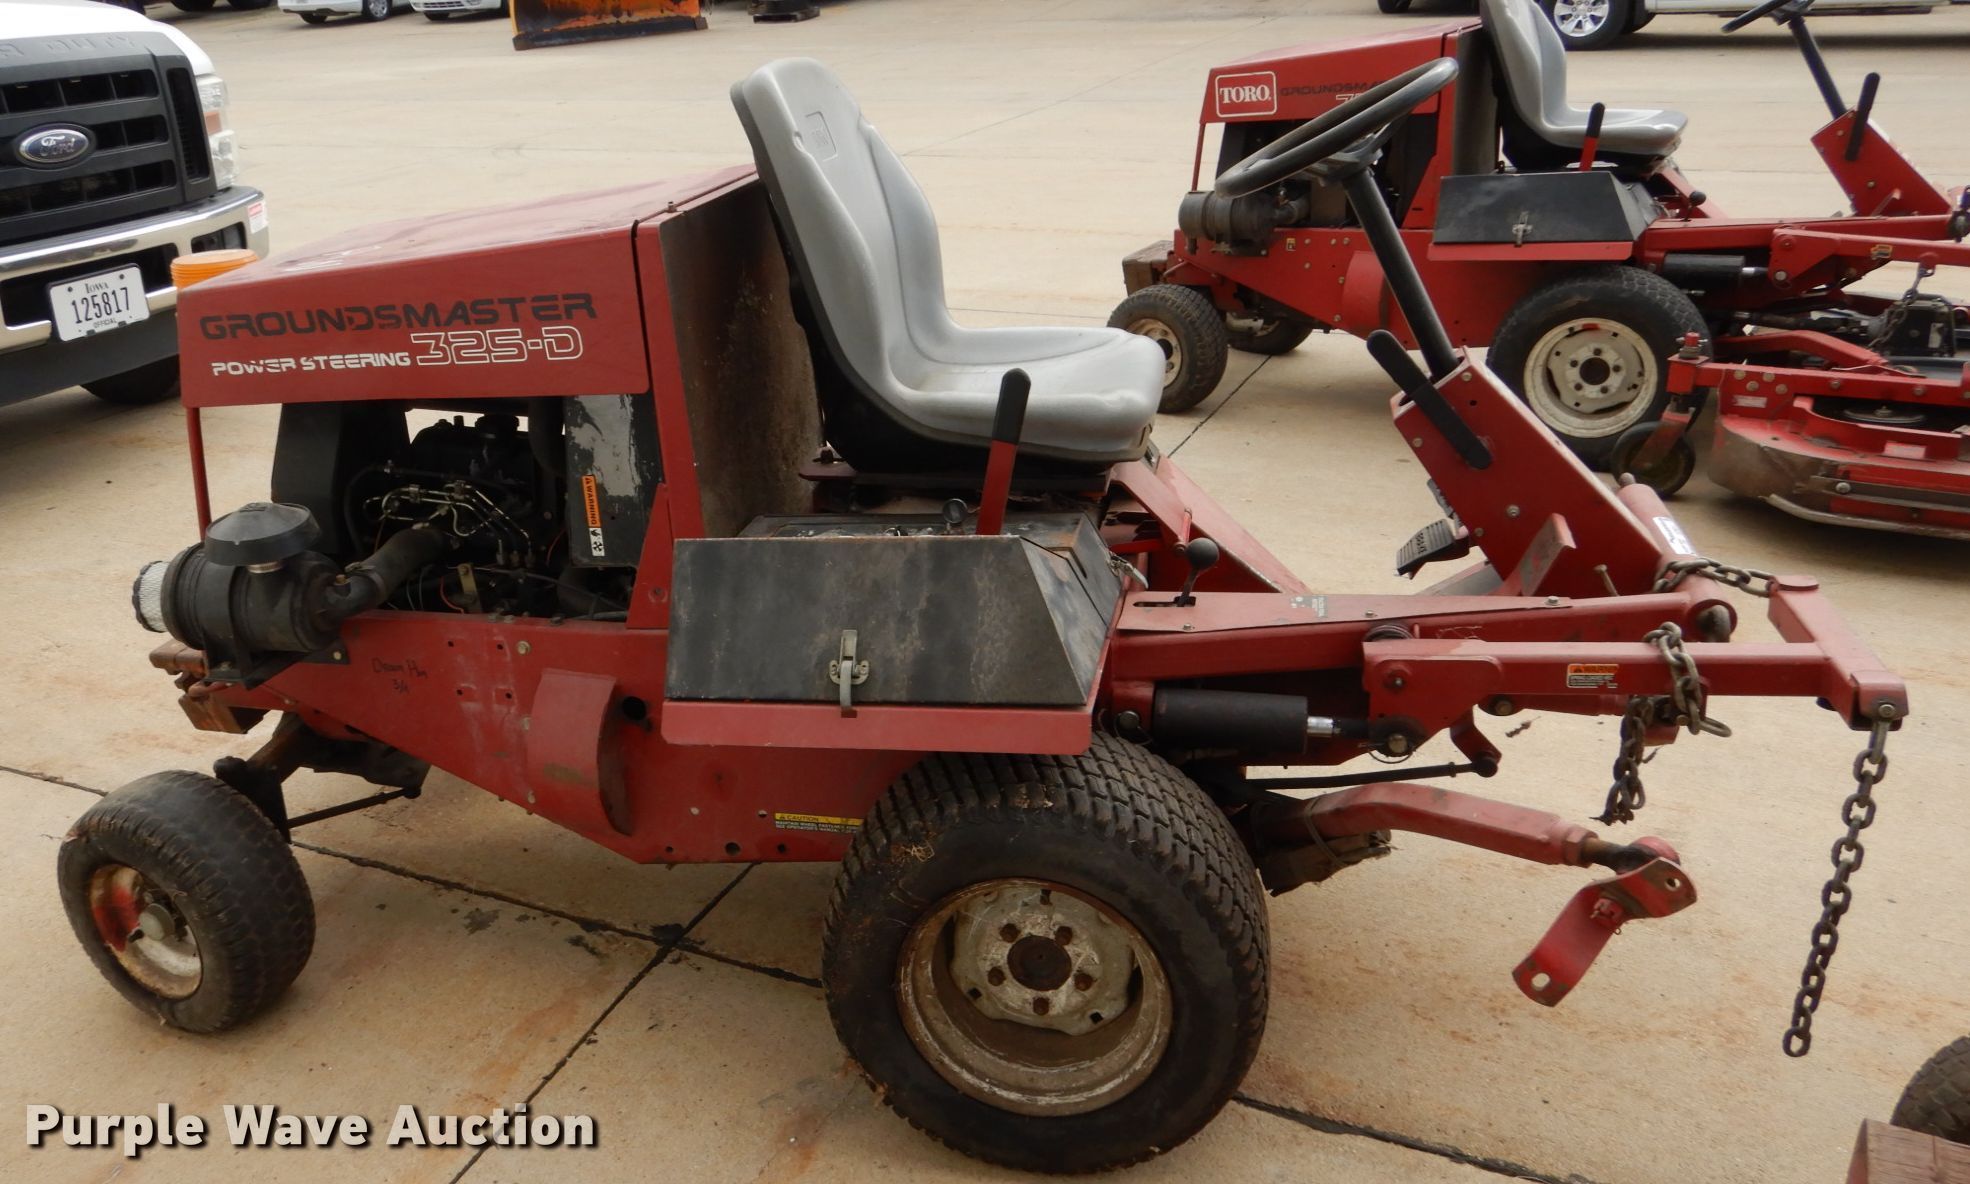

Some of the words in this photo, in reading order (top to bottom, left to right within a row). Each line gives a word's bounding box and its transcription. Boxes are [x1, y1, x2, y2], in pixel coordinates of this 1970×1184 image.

[41, 135, 76, 157] Ford
[71, 287, 129, 324] 125817
[200, 293, 598, 340] GROUNDSMASTER
[211, 358, 296, 376] POWER
[299, 351, 411, 371] STEERING
[410, 325, 584, 366] 325-D
